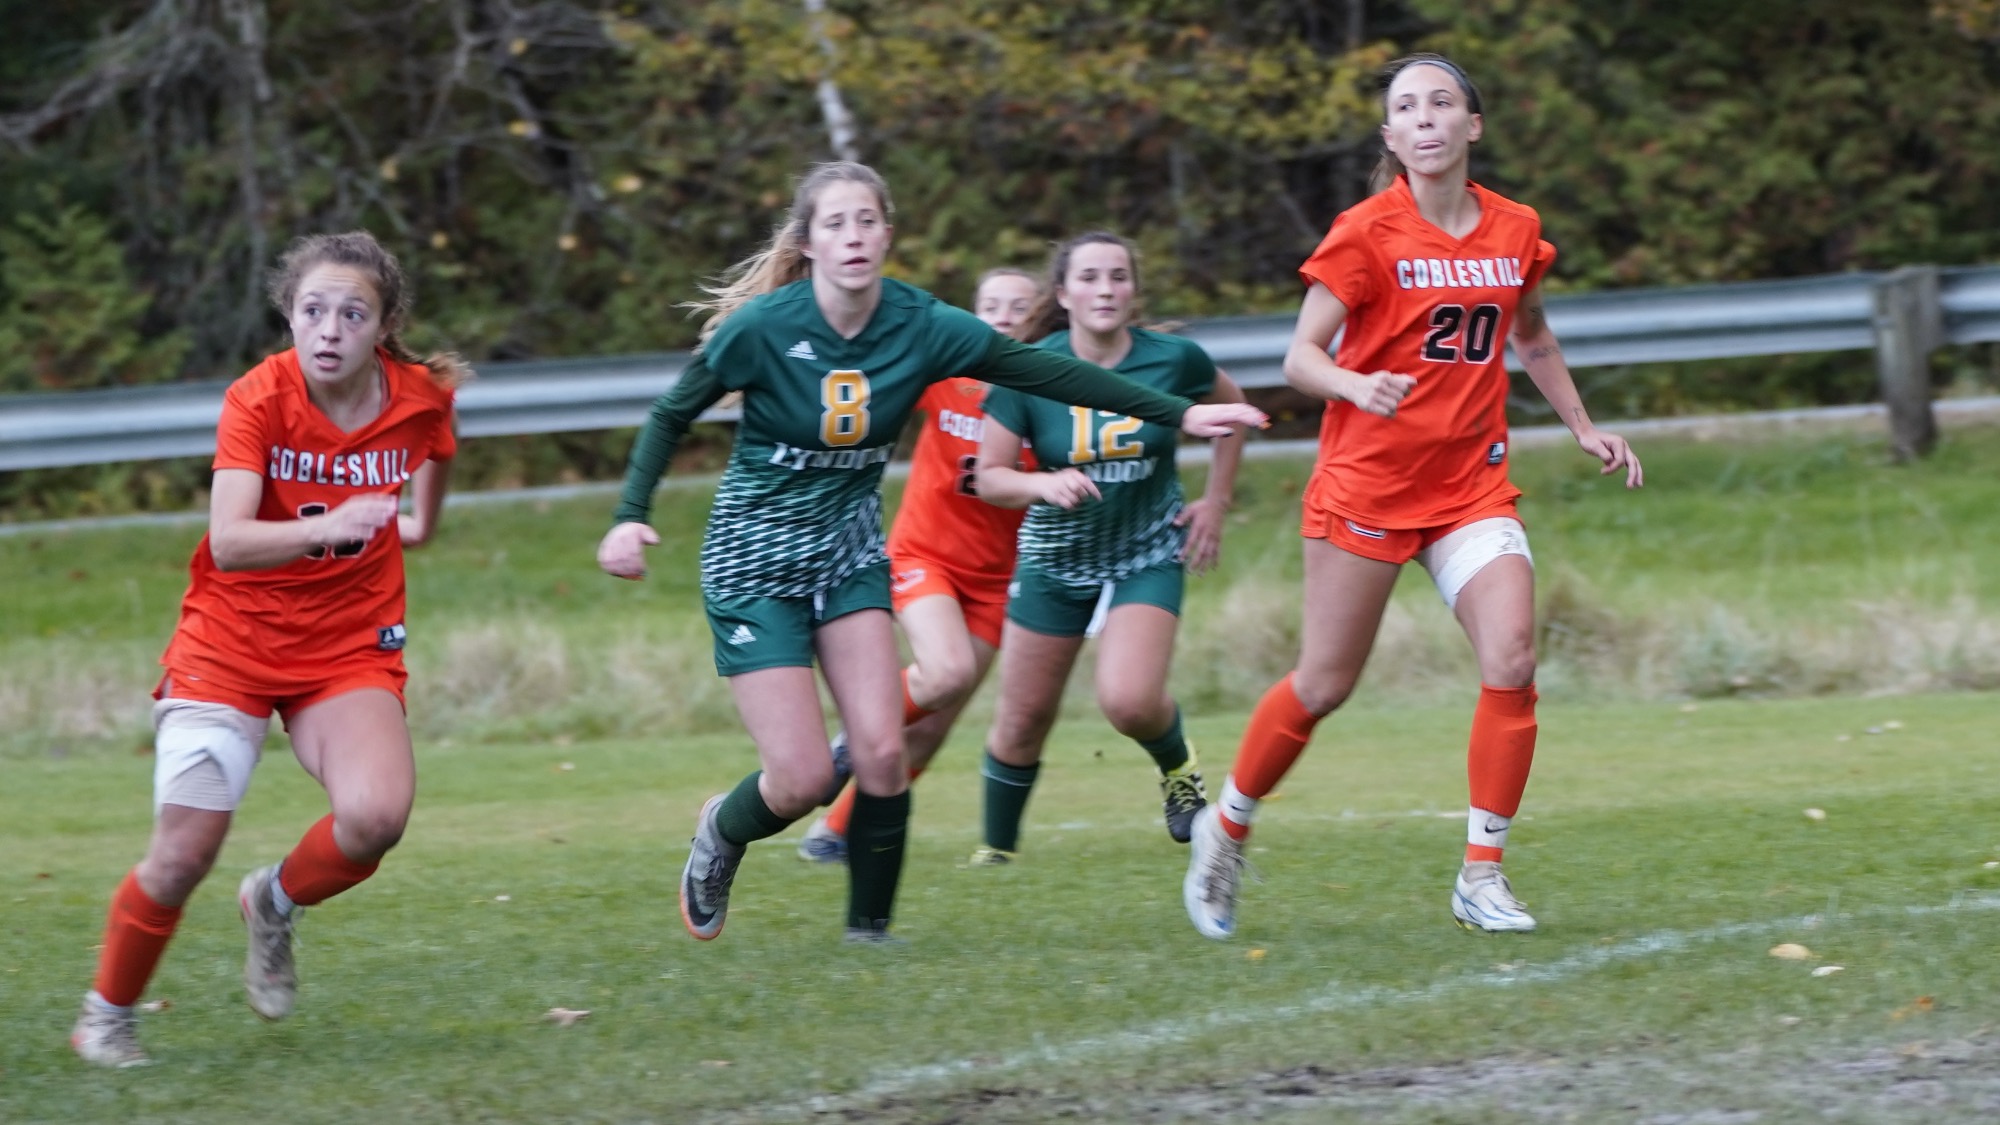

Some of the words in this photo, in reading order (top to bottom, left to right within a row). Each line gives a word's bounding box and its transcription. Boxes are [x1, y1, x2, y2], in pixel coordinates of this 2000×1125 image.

[1396, 257, 1525, 289] COBLESKILL
[1420, 303, 1502, 364] 20
[819, 369, 871, 447] 8
[1067, 405, 1145, 465] 12
[269, 445, 411, 487] COBLESKILL
